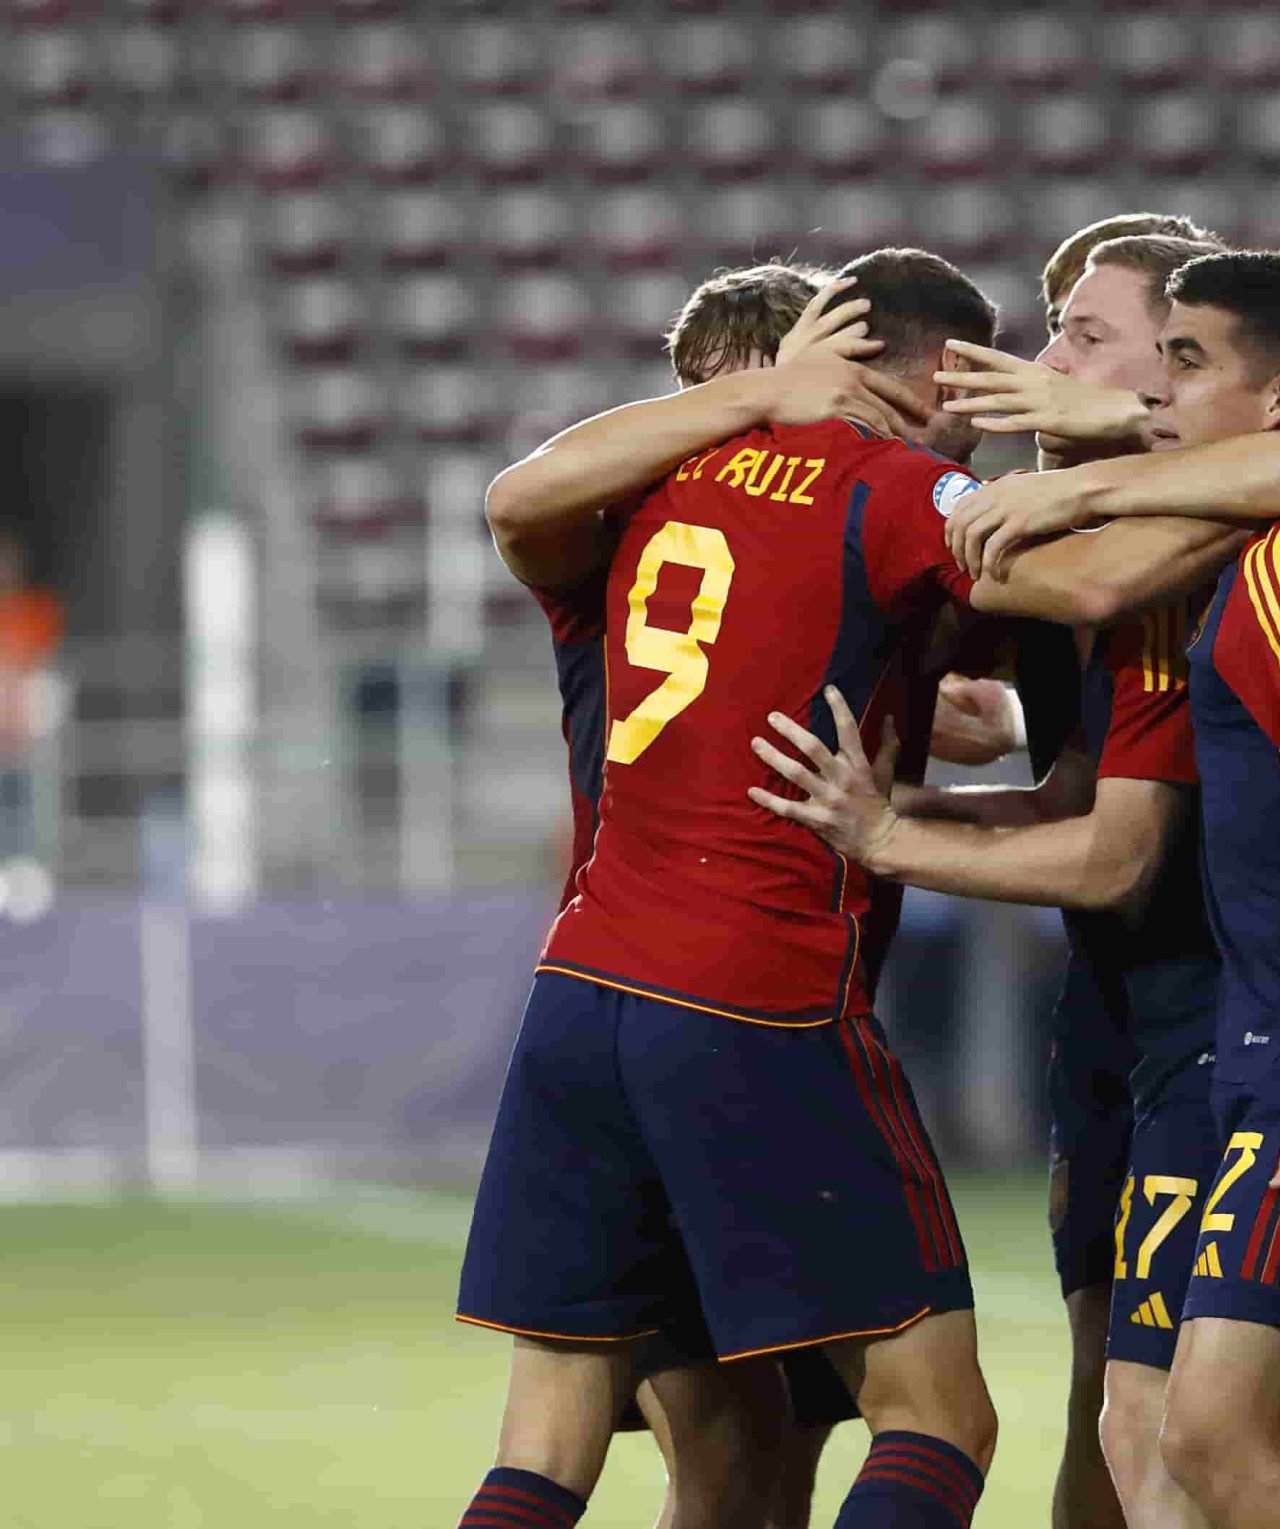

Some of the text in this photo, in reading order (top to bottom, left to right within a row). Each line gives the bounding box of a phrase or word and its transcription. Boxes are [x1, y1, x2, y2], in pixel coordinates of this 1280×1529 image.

[715, 447, 826, 506] RUIZ
[606, 520, 735, 765] 9
[1114, 1174, 1199, 1280] 17
